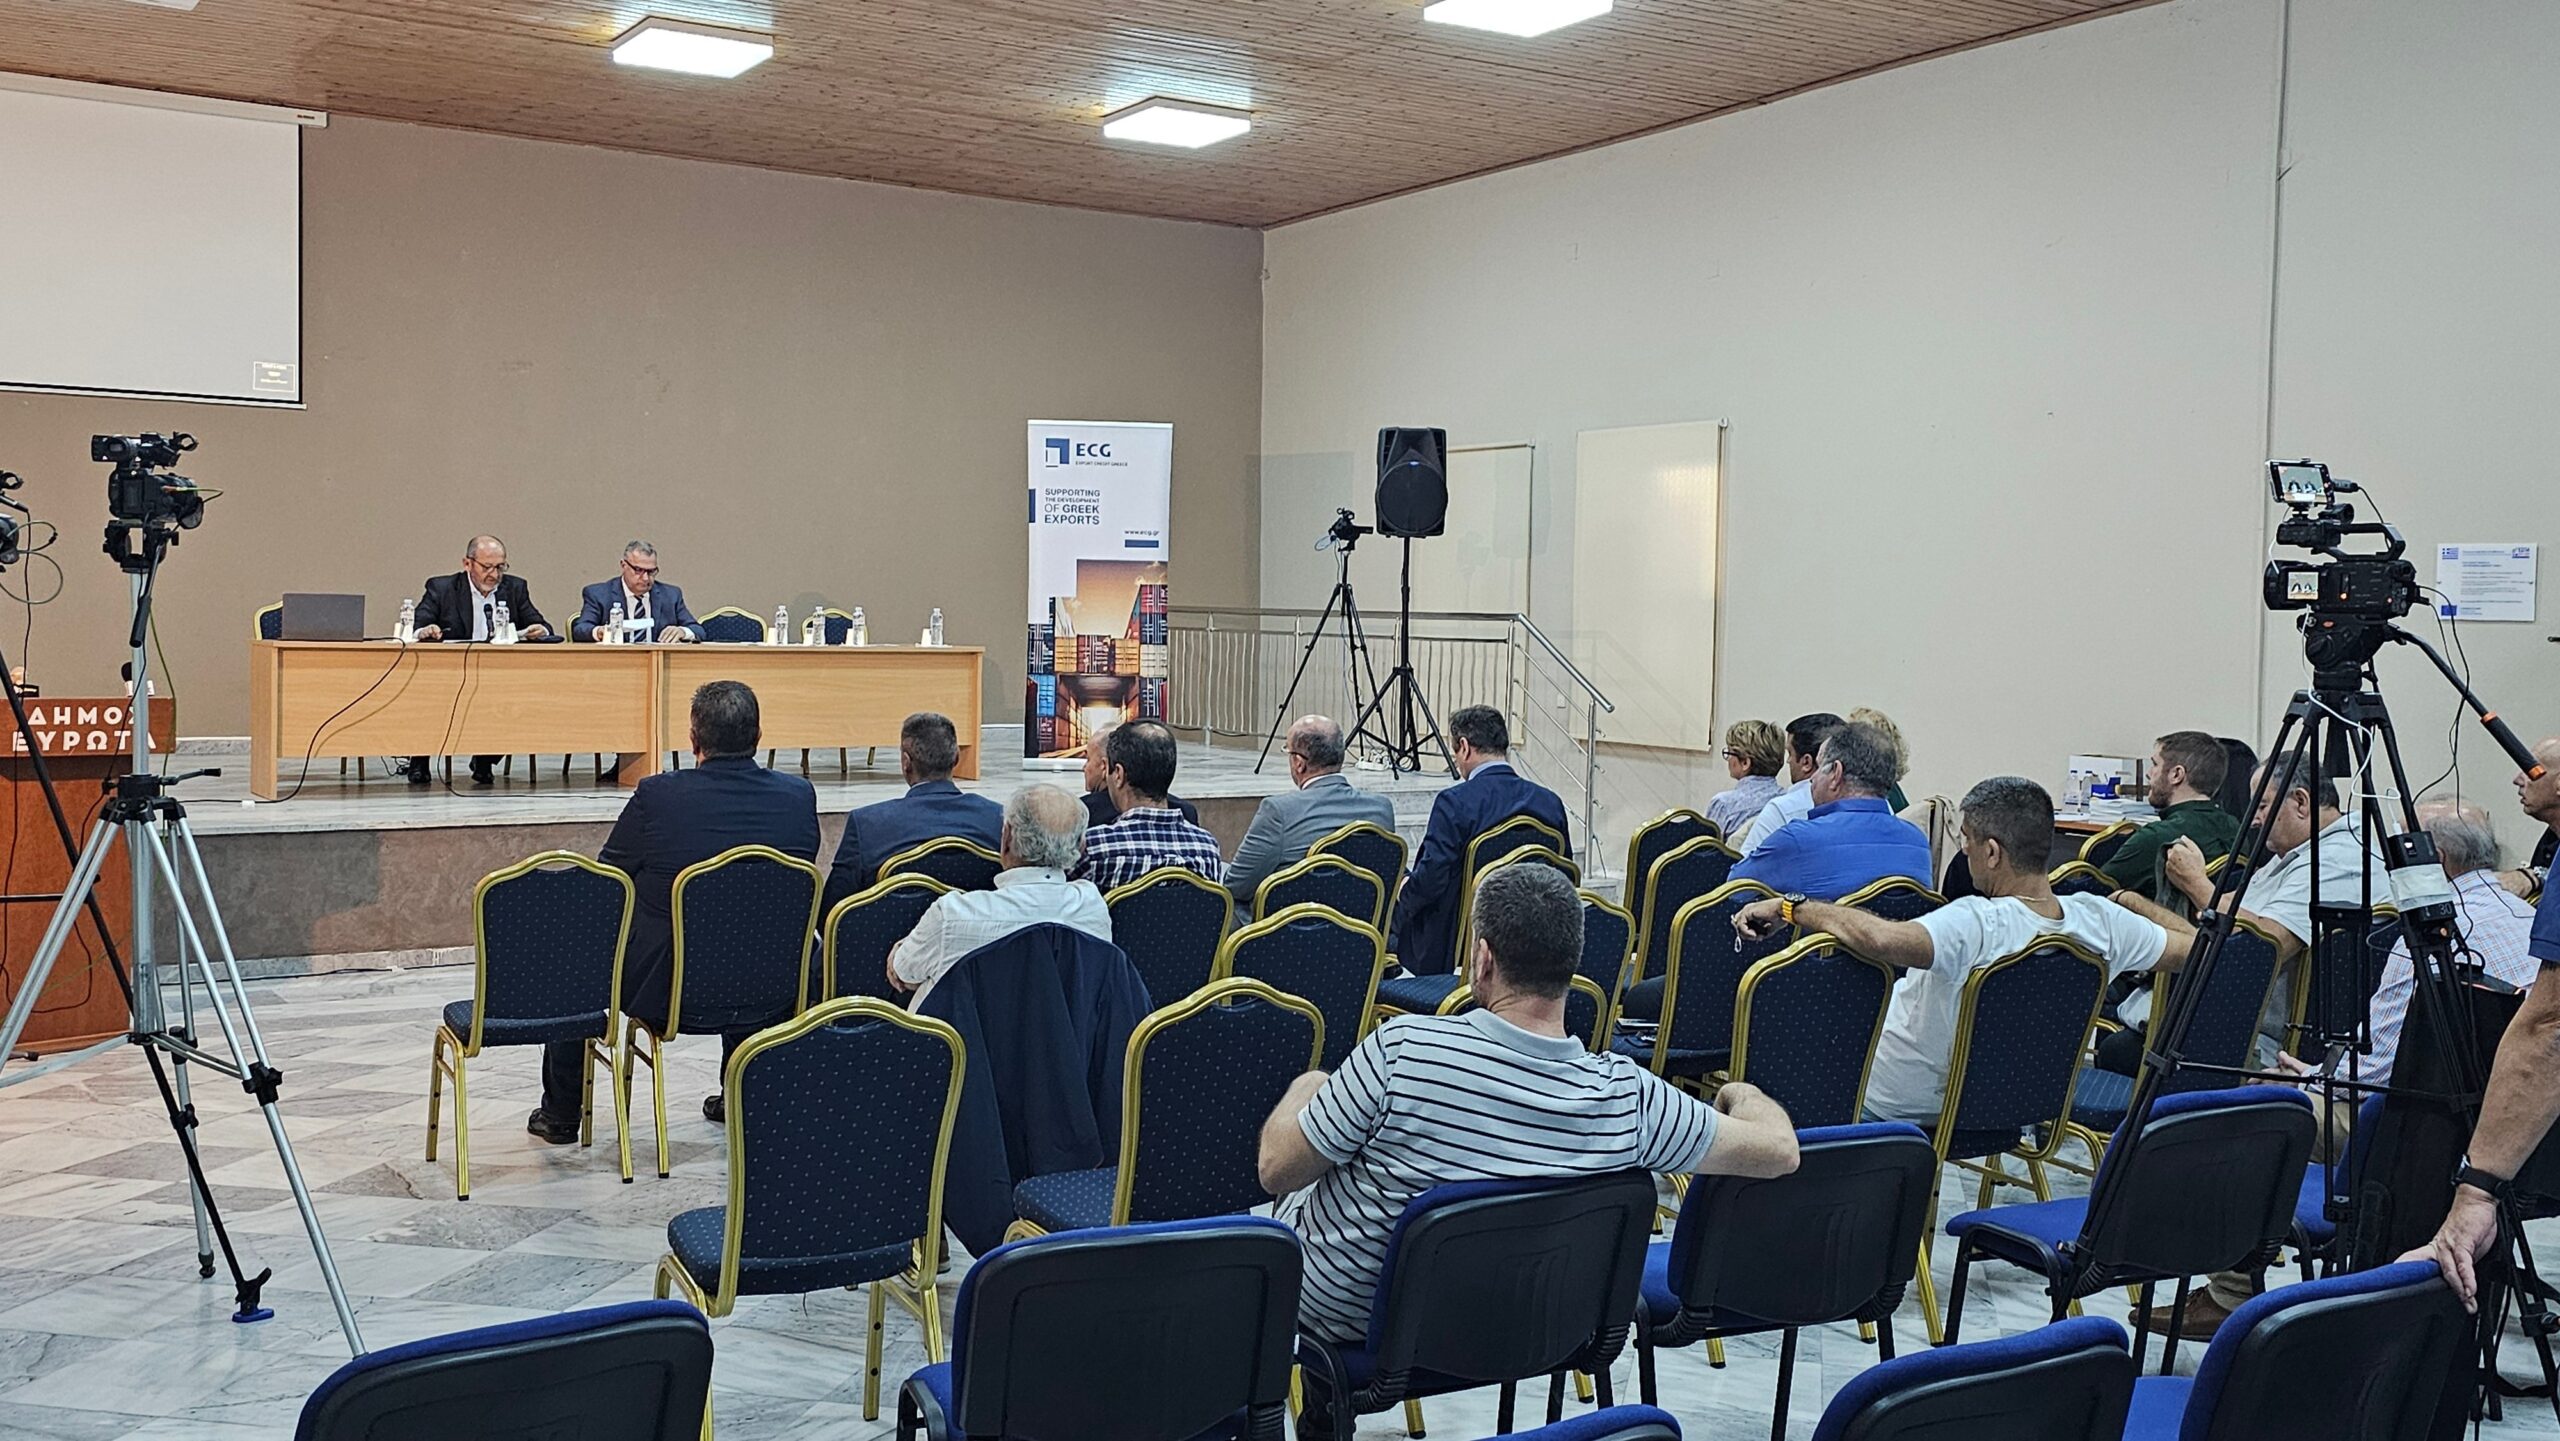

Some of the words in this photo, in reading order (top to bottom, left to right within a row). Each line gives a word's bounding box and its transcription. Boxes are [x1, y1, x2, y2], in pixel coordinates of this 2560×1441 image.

[1076, 443, 1111, 457] ECG
[1045, 488, 1100, 497] SUPPORTING
[1044, 503, 1060, 513] OF
[1062, 504, 1100, 514] GREEK
[1044, 514, 1100, 525] EXPORTS
[2439, 903, 2453, 915] 30
